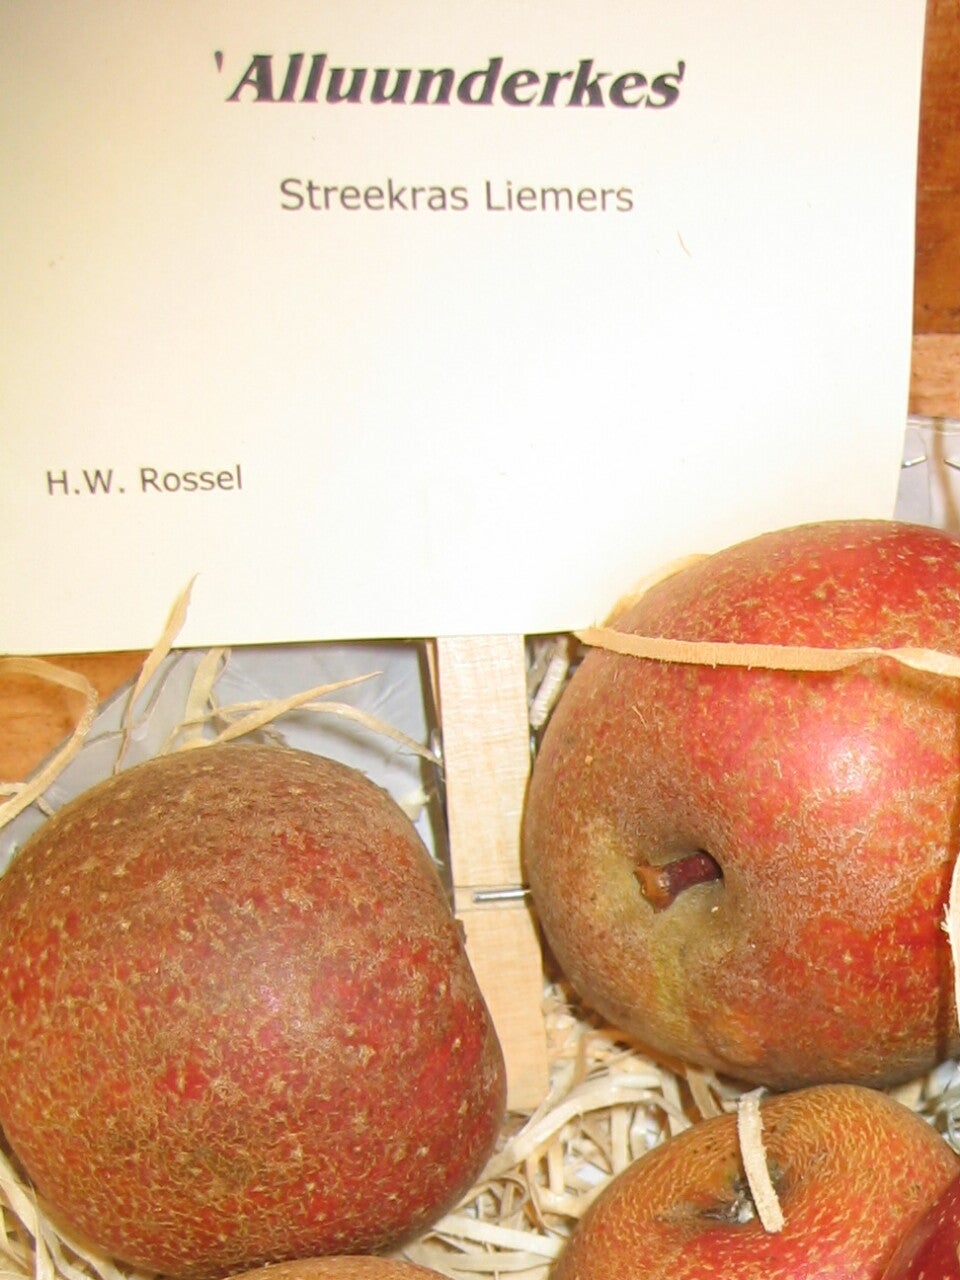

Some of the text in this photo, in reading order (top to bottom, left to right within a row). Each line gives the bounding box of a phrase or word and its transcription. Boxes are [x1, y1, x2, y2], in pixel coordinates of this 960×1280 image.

[213, 49, 686, 108] 'Alluunderkes'
[280, 177, 635, 213] Streekras Liemers
[46, 464, 243, 495] H.W. Rossel
